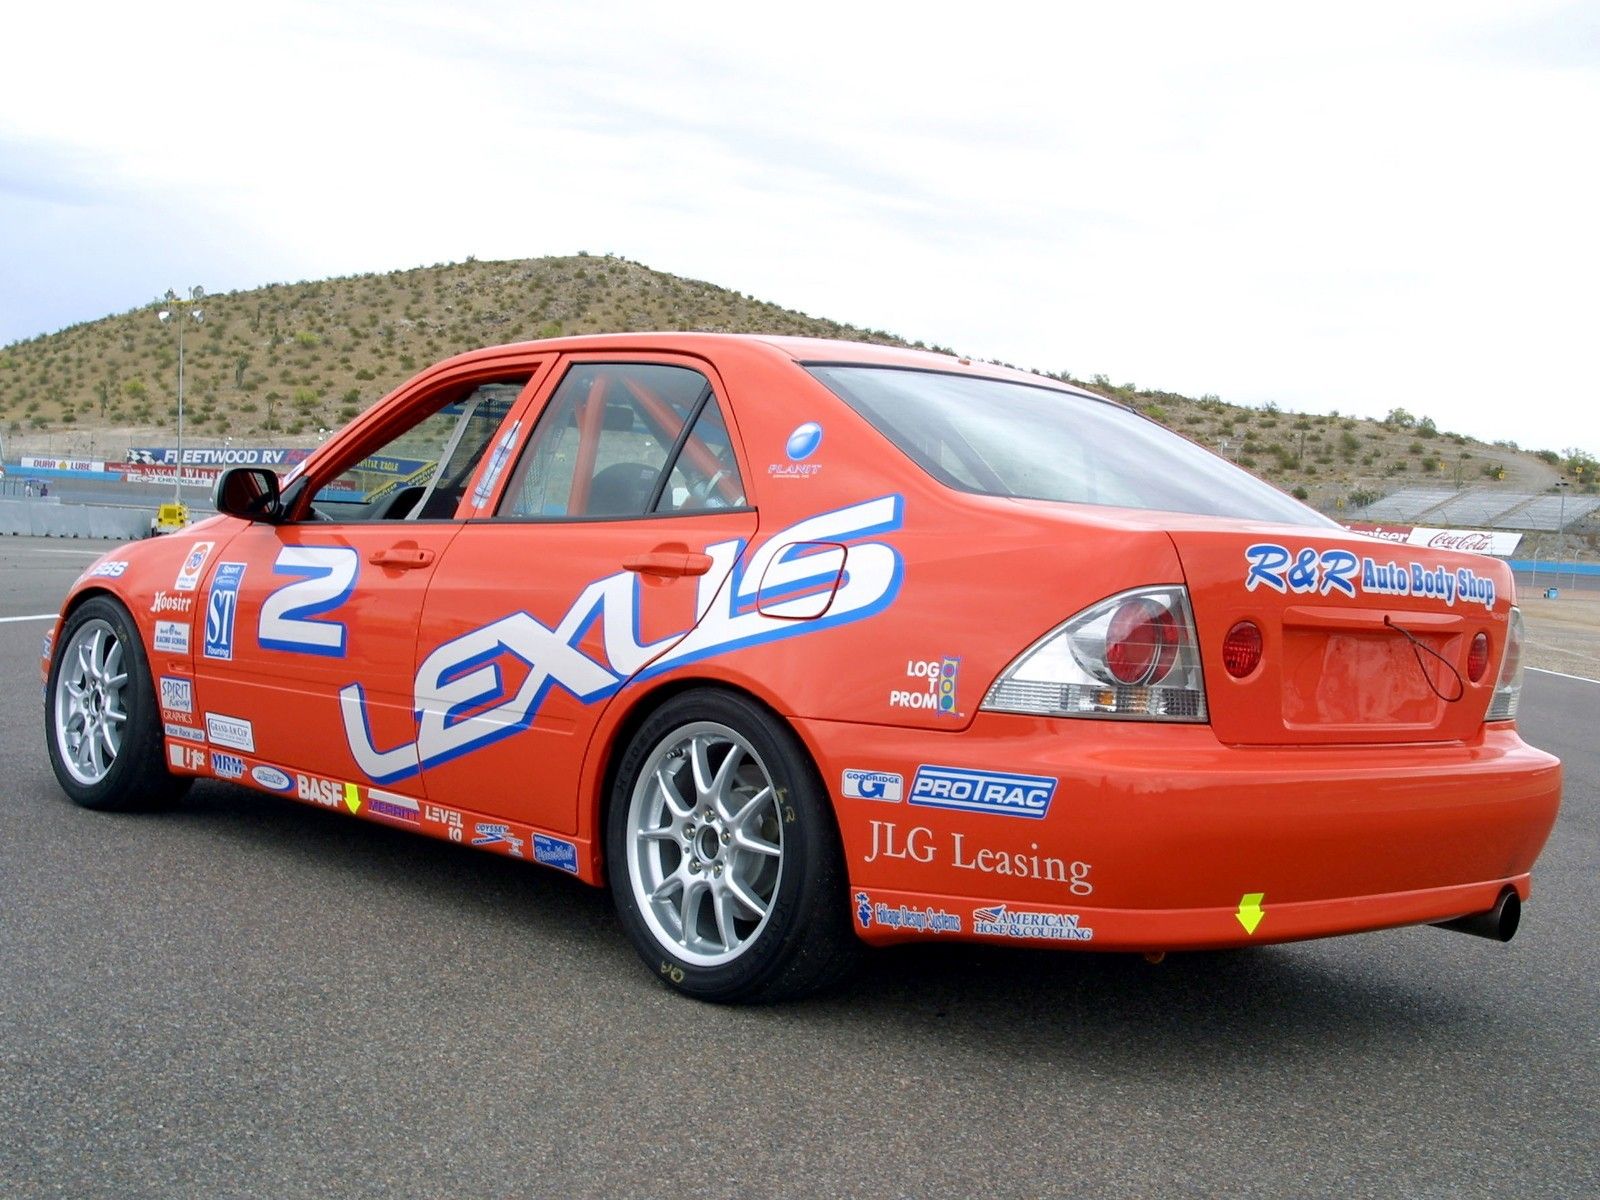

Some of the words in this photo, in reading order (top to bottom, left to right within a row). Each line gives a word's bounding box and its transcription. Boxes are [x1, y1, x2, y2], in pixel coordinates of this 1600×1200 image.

[33, 460, 56, 469] DURA
[70, 462, 92, 471] LUBE
[163, 450, 258, 464] FLEETWOOD
[261, 450, 285, 464] RV
[1246, 544, 1357, 597] R&R
[1362, 559, 1408, 593] Auto
[1411, 563, 1454, 606] Body
[1458, 569, 1496, 609] Shop
[151, 592, 192, 613] Hoosier
[258, 545, 359, 657] 2
[207, 589, 235, 644] ST
[339, 495, 904, 784] LEXUS
[208, 646, 229, 659] Touring
[907, 660, 940, 677] LOG
[162, 681, 188, 699] SPIRIT
[889, 690, 938, 710] PROM
[846, 773, 900, 784] GOODRIDGE
[296, 773, 343, 808] BASF
[913, 778, 1048, 808] PROTRAC
[425, 805, 464, 828] LEVEL
[448, 826, 462, 842] 10
[475, 823, 508, 833] ODYSSEY
[864, 820, 938, 863] JLG
[951, 832, 1093, 896] Leasing
[901, 905, 926, 931] Design
[927, 907, 960, 932] Systems
[998, 912, 1078, 927] AMERICAN
